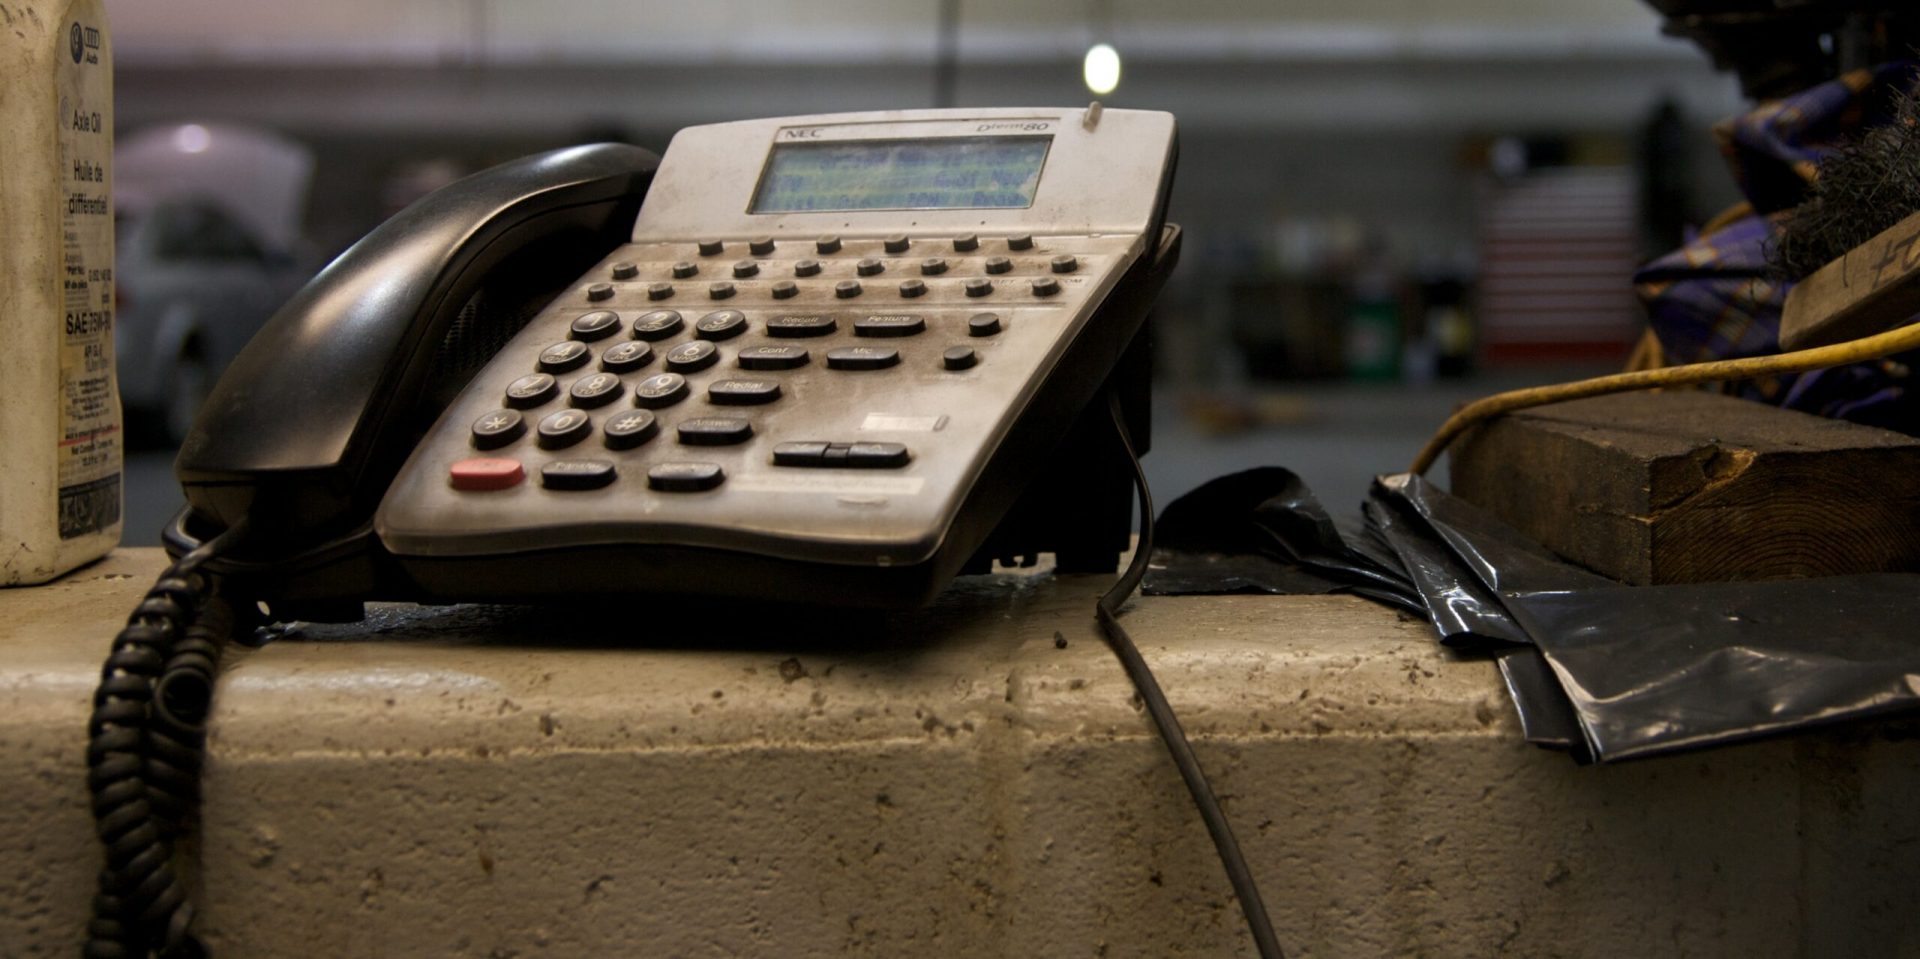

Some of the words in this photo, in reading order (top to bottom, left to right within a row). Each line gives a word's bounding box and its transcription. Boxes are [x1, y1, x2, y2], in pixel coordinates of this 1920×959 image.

[72, 108, 90, 132] Axle
[785, 128, 824, 139] NEC
[94, 161, 103, 183] de
[66, 312, 88, 335] SAE
[647, 312, 669, 327] 2
[712, 312, 731, 326] 3
[782, 316, 819, 324] Recall
[867, 315, 910, 323] Feature
[620, 342, 640, 355] 5
[683, 342, 702, 356] 6
[758, 346, 789, 354] Conf
[588, 376, 606, 389] 8
[656, 376, 674, 389] 9
[724, 380, 763, 389] Redial
[554, 416, 573, 430] 0
[615, 416, 643, 430] #
